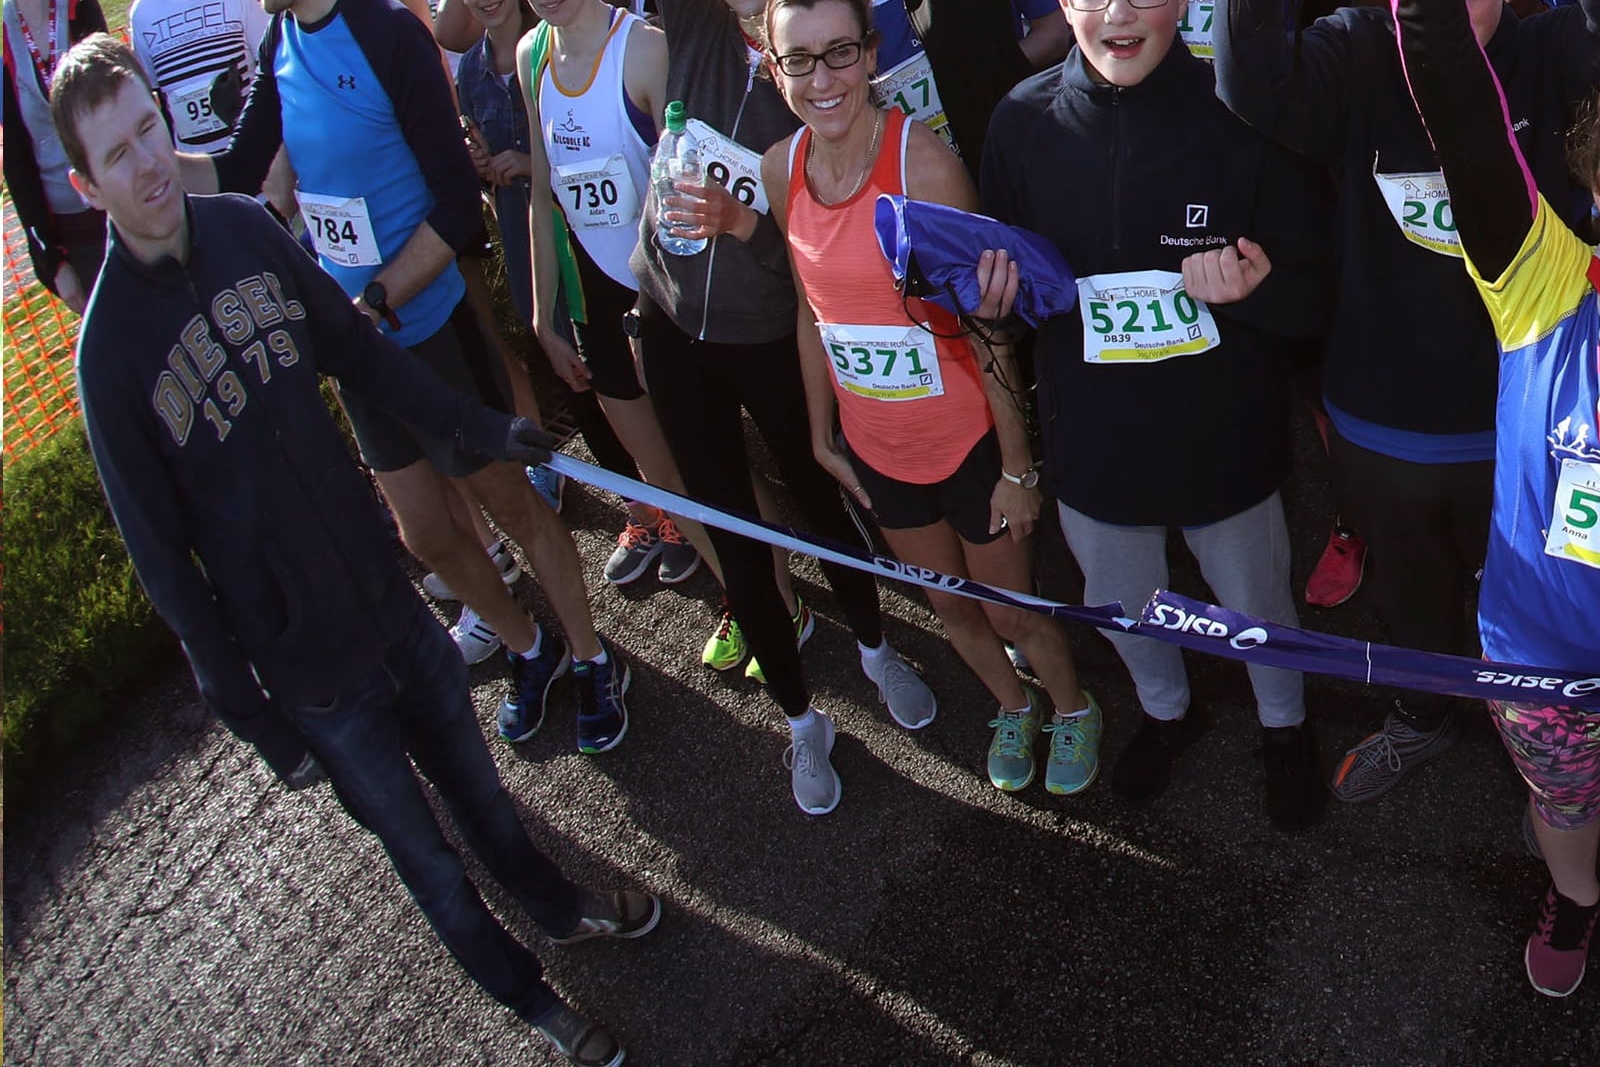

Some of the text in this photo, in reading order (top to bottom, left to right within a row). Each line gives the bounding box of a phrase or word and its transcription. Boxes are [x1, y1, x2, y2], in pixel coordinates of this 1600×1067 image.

[143, 1, 243, 49] DIESEL
[1512, 118, 1531, 132] ank
[567, 179, 618, 210] 730
[310, 215, 359, 245] 784
[1160, 234, 1228, 247] Deutsche Bank
[1089, 289, 1199, 335] 5210
[1103, 334, 1131, 343] DB39
[152, 271, 307, 447] DIESEL
[829, 342, 928, 377] 5371
[203, 329, 300, 442] 1979
[1561, 525, 1588, 540] Anna
[1148, 603, 1229, 638] asics
[1475, 670, 1564, 690] asics
